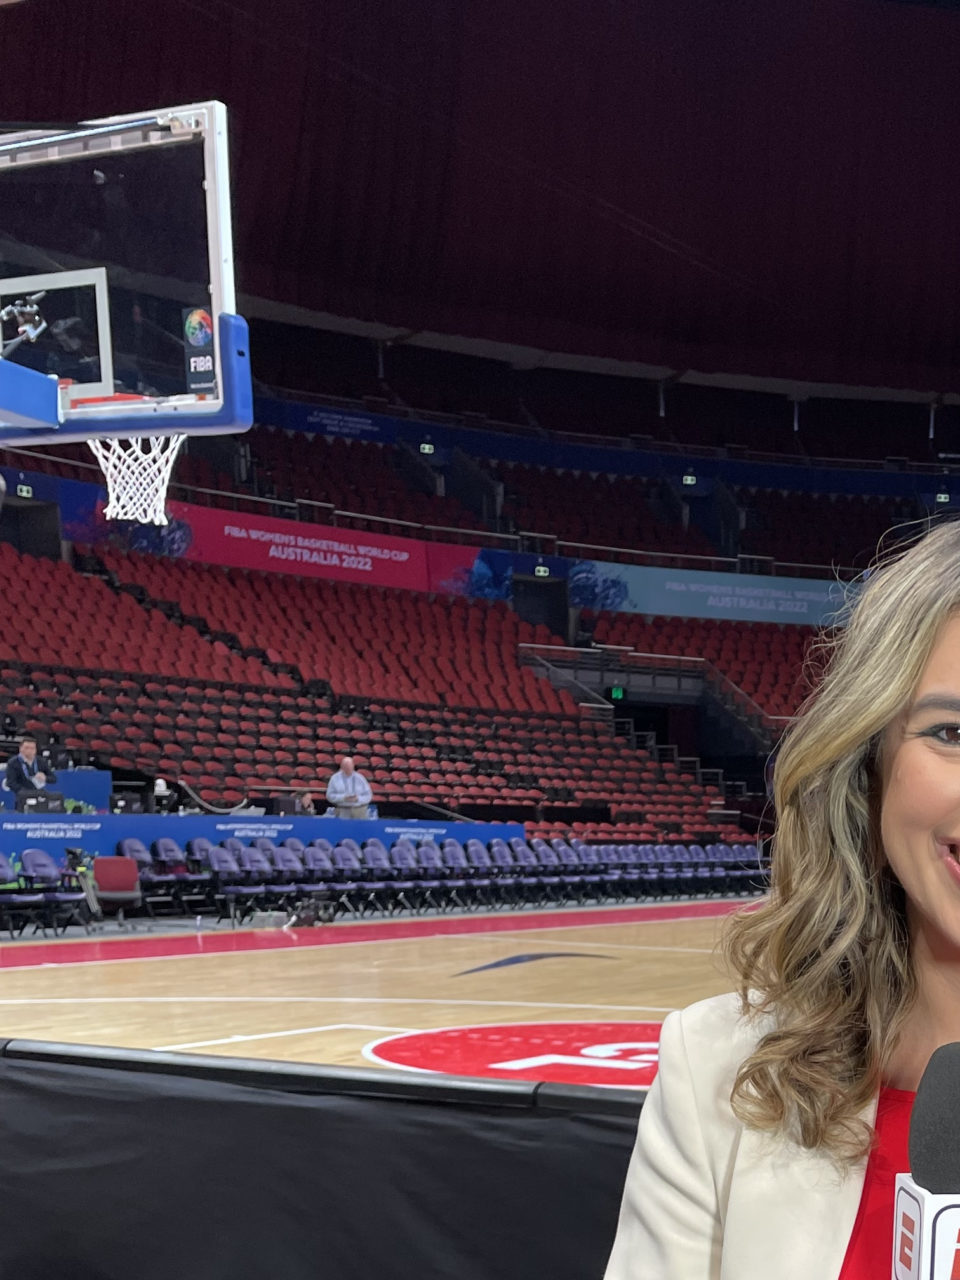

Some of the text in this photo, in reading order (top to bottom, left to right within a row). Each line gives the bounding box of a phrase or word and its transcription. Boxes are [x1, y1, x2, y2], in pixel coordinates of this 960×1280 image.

[190, 355, 213, 372] FIBA
[224, 525, 248, 538] FIBA
[297, 536, 357, 555] BASKETBALL
[356, 545, 391, 559] WORLD
[390, 550, 409, 562] CUP
[269, 545, 373, 571] AUSTRALIA 2022
[708, 595, 776, 610] AUSTRALIA
